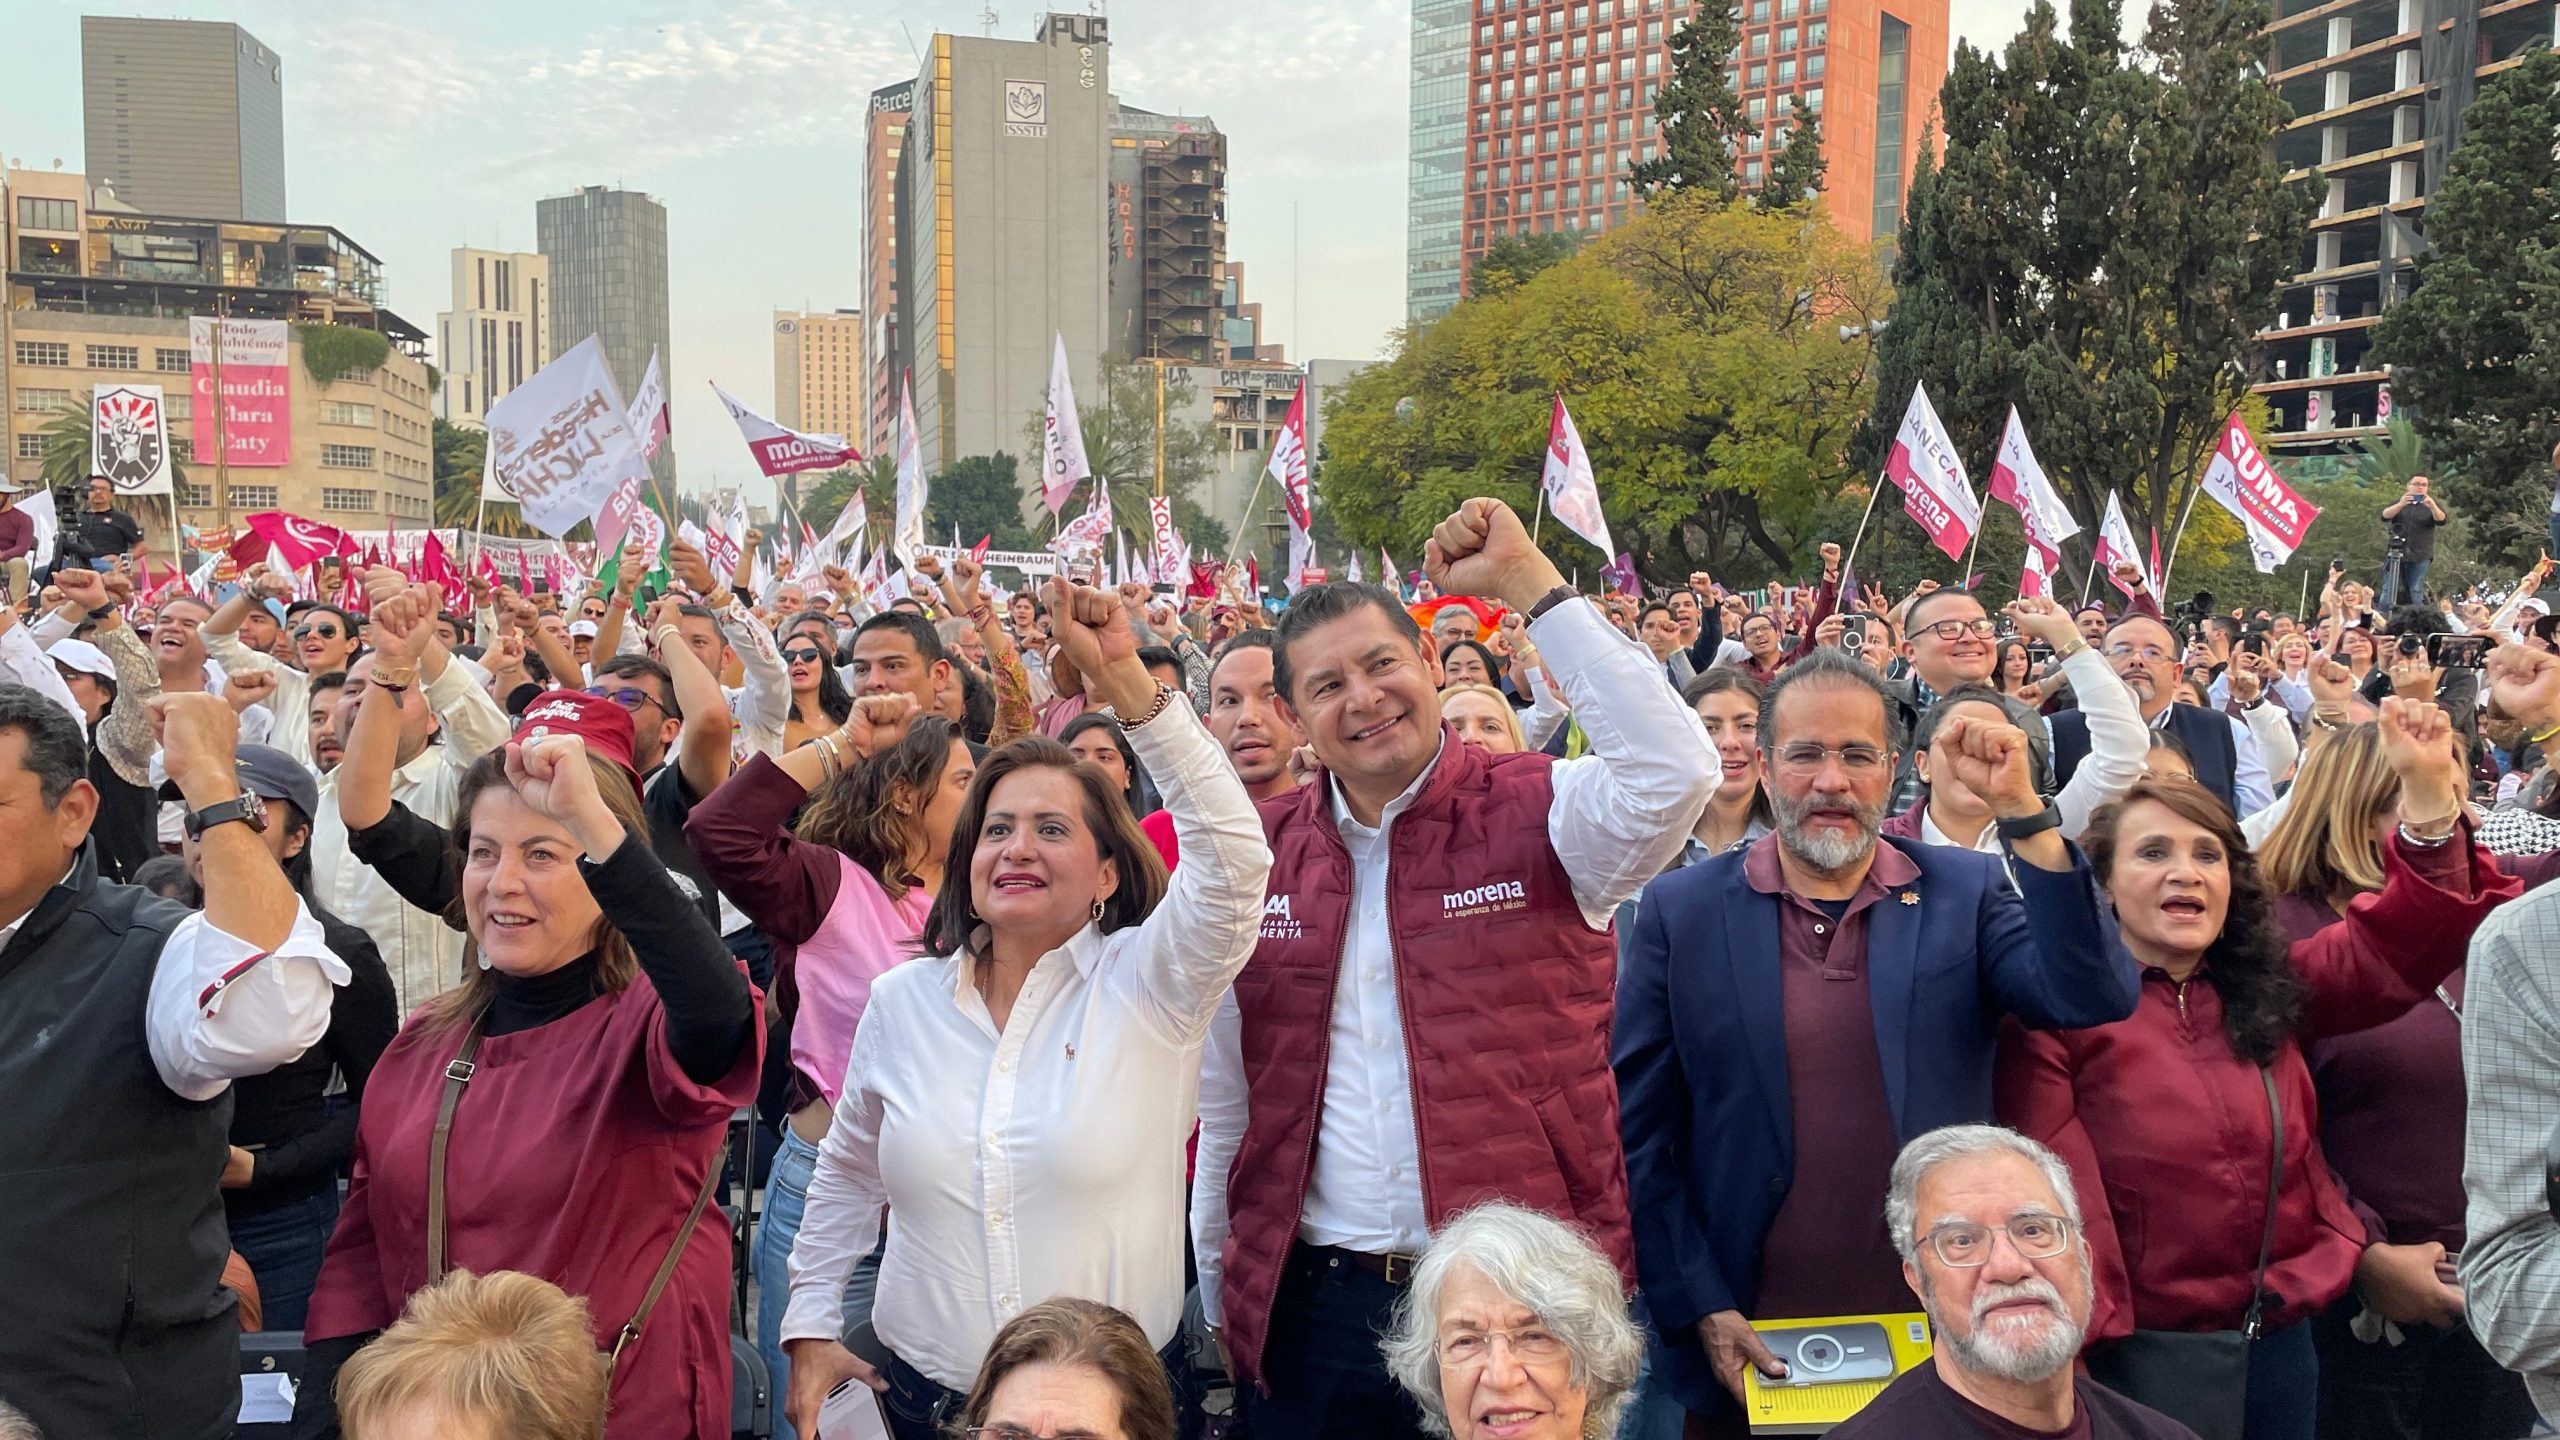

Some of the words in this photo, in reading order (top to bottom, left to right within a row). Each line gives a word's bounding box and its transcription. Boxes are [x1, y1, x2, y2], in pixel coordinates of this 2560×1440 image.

[872, 83, 914, 116] Barcel
[224, 323, 258, 336] Todo
[233, 352, 249, 361] es
[2230, 427, 2299, 525] SUMA
[1905, 473, 1950, 530] orena
[986, 552, 1055, 566] HEINBAUM
[1443, 880, 1525, 910] morena
[1443, 910, 1453, 919] La
[1455, 905, 1490, 918] esperanza
[1492, 902, 1501, 911] de
[1502, 899, 1527, 911] México
[1263, 919, 1301, 928] JANDRO
[1259, 926, 1302, 939] MENTA
